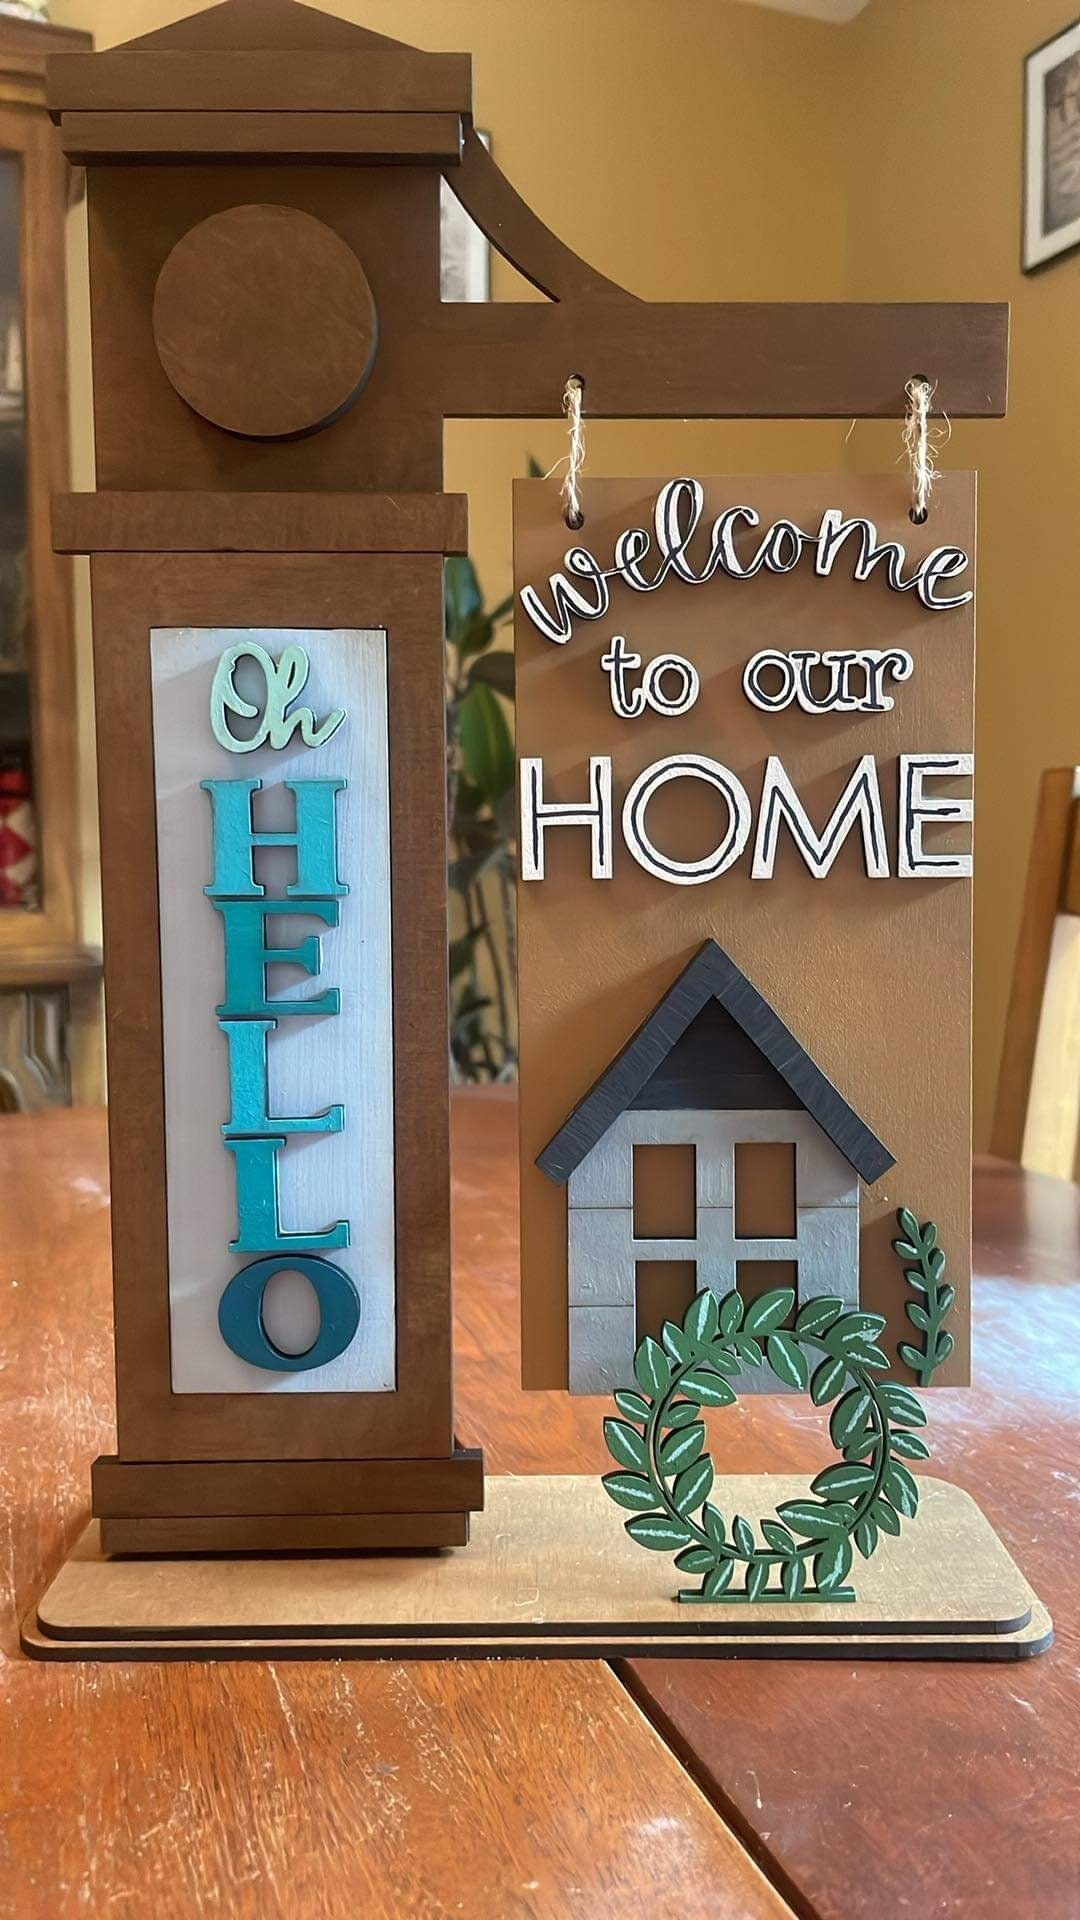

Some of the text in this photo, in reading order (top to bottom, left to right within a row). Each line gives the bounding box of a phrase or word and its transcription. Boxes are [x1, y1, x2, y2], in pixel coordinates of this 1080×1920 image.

[519, 478, 974, 644] welcome
[210, 641, 347, 754] Oh
[601, 636, 914, 719] to our
[520, 753, 974, 885] HOME
[200, 779, 360, 1372] HELLO
